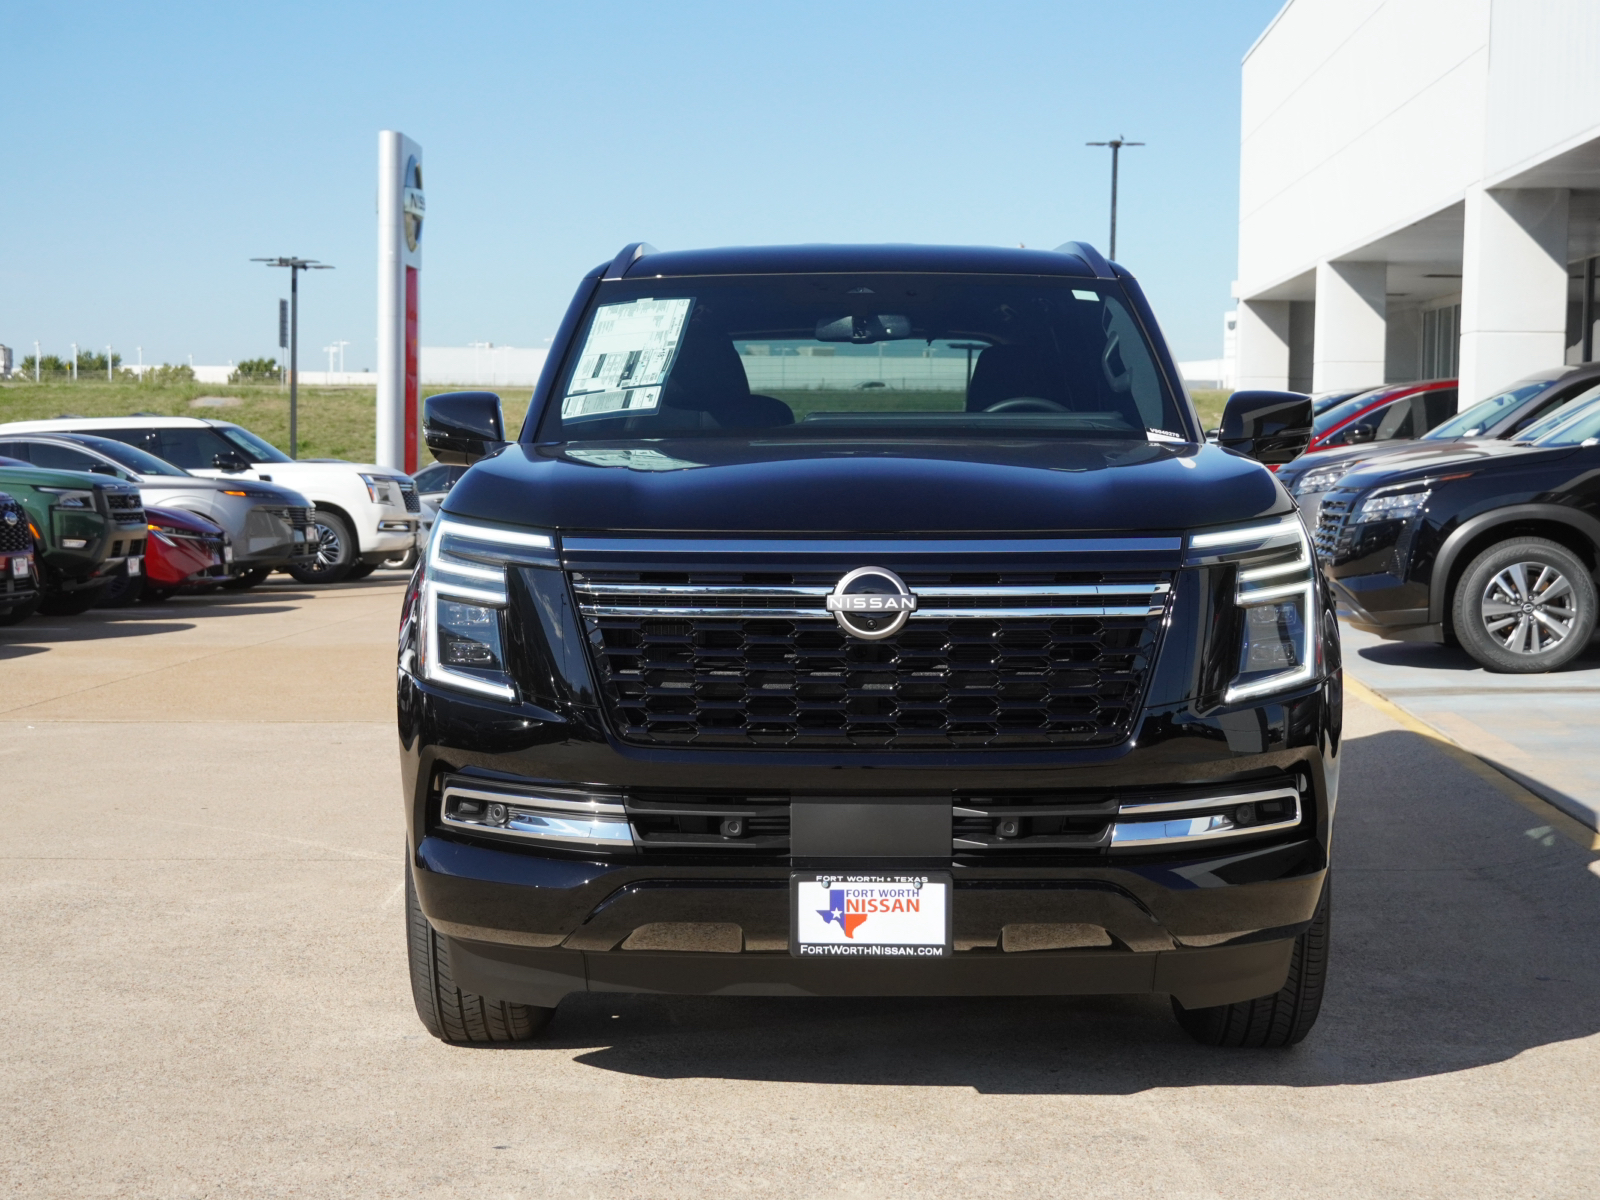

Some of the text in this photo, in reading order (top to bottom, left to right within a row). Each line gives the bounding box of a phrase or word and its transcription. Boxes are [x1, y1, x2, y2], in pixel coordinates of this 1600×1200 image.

[829, 598, 914, 608] NISSAN
[846, 889, 920, 897] FORT WORTH
[846, 899, 920, 912] NISSAN
